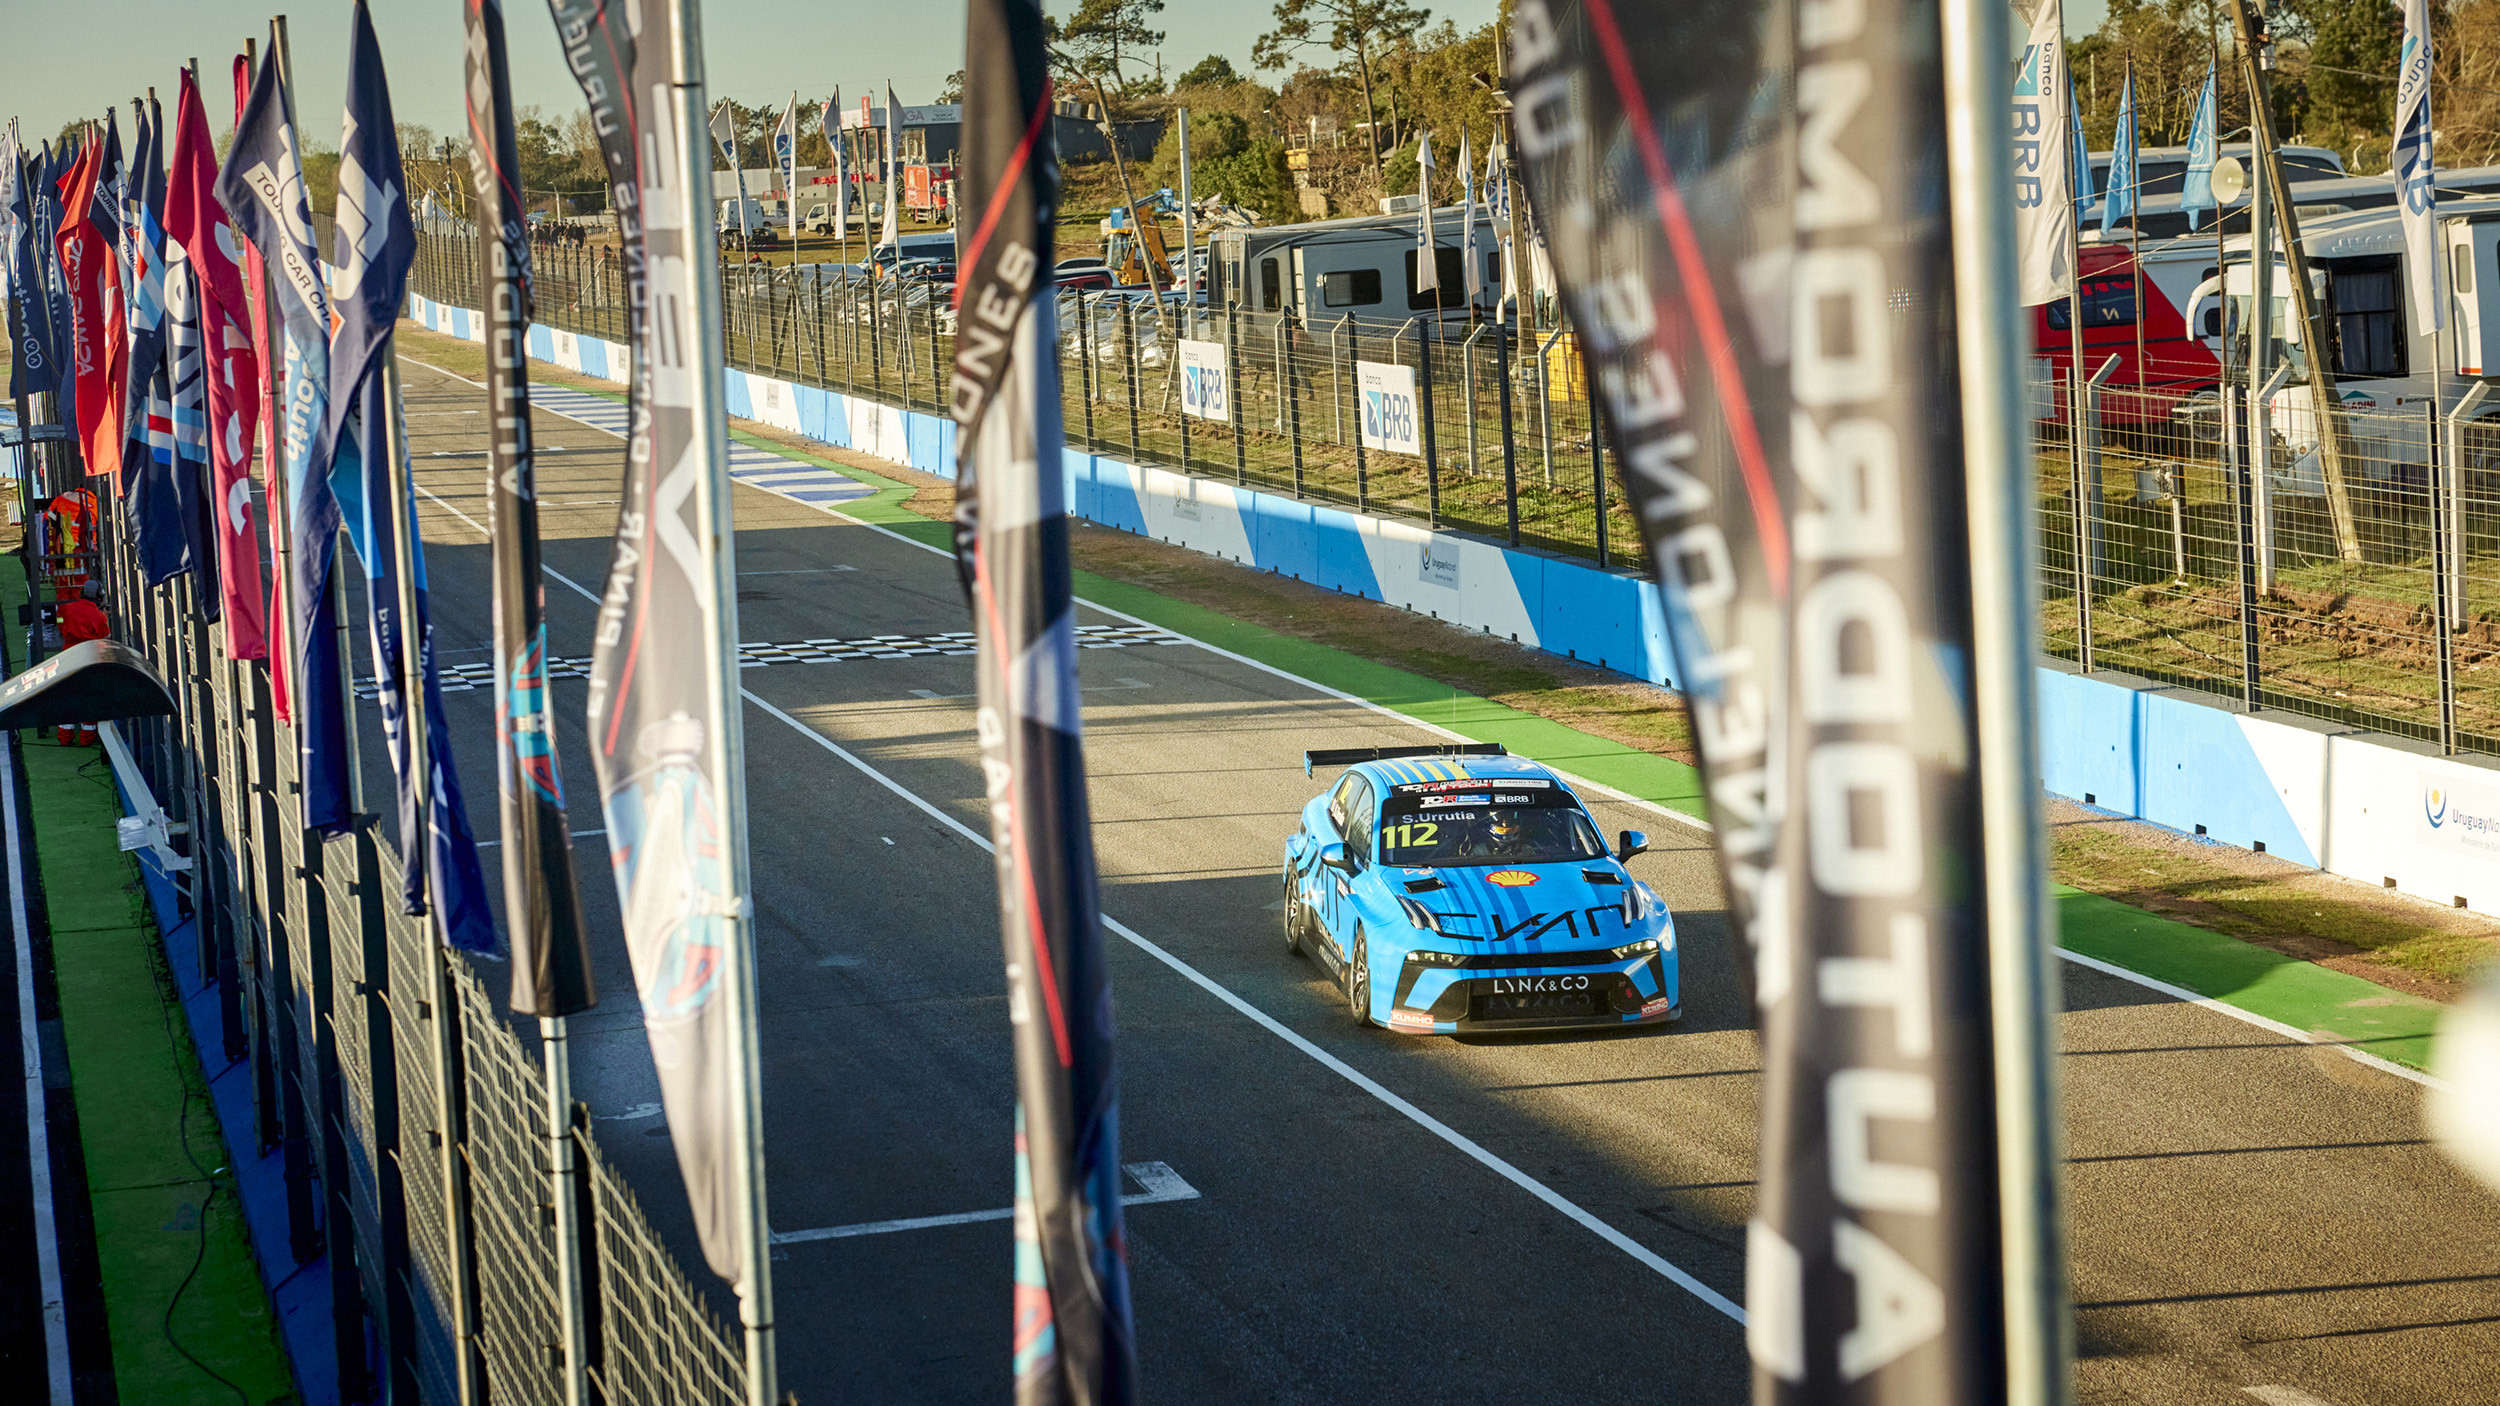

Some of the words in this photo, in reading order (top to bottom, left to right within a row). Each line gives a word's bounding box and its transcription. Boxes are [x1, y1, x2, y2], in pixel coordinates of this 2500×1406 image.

[2043, 43, 2054, 96] banco
[2012, 104, 2043, 209] BRB
[286, 252, 312, 289] CAR
[1200, 367, 1222, 410] BRB
[1365, 372, 1382, 386] banco
[1383, 393, 1411, 442] BRB
[1420, 794, 1457, 805] TCR
[1507, 795, 1529, 803] BRB
[1402, 811, 1475, 824] S.Urrutia
[2452, 808, 2500, 834] UruguayNa
[1382, 822, 1438, 849] 112
[1493, 975, 1590, 994] LYNK&CO
[1642, 1000, 1669, 1014] KUMHO
[1392, 1012, 1434, 1026] KUMHO
